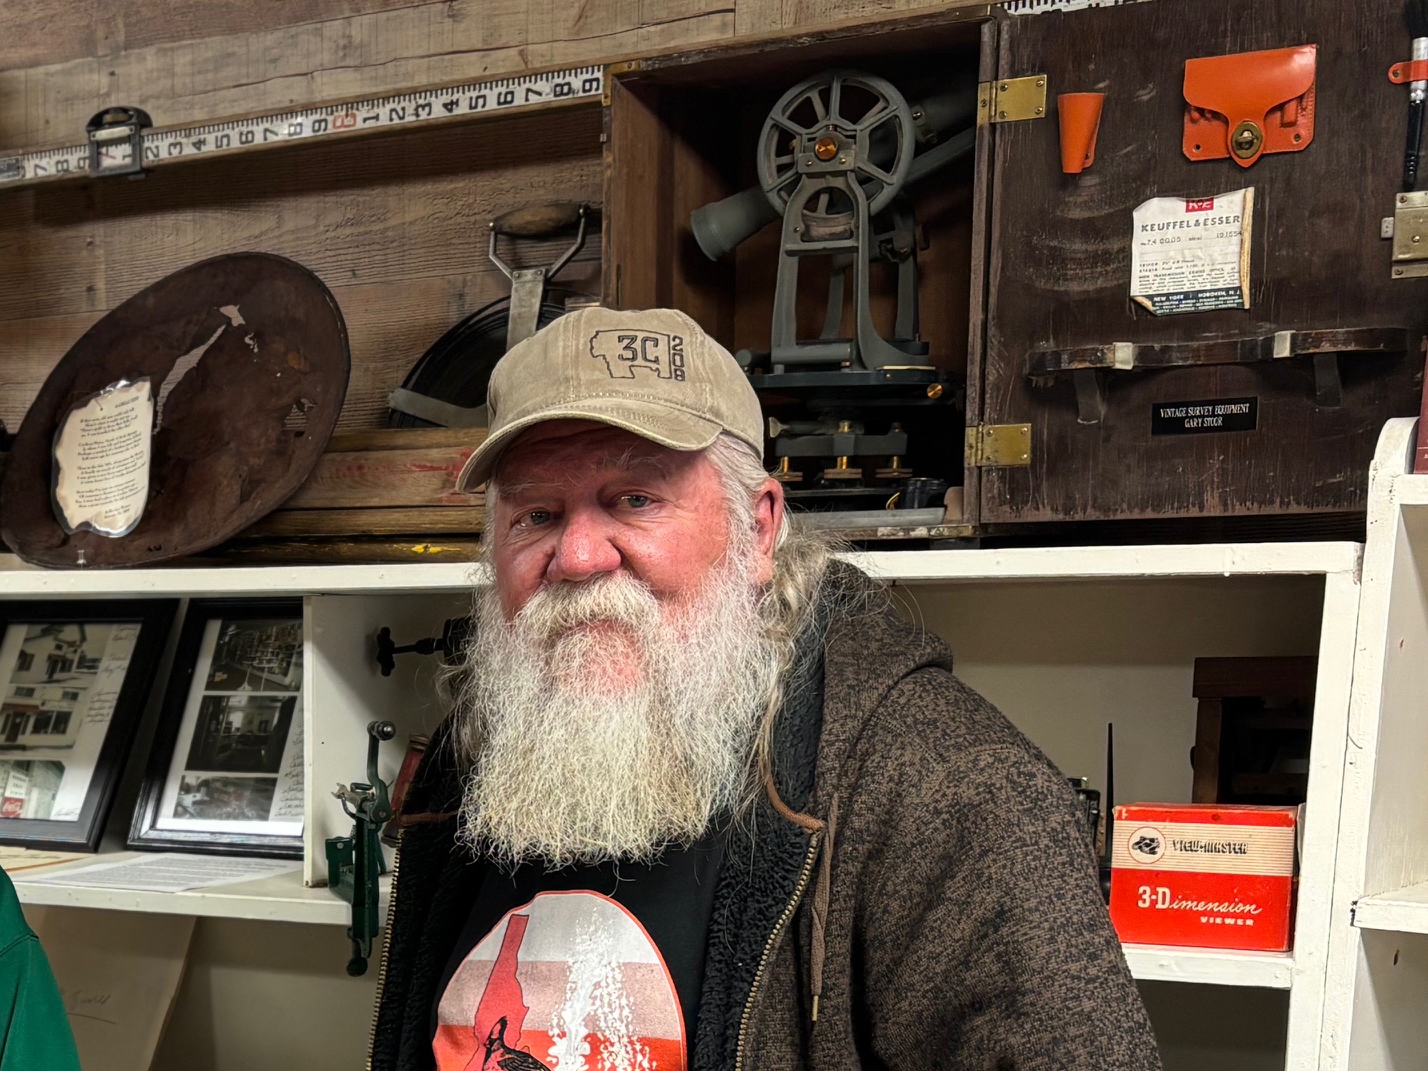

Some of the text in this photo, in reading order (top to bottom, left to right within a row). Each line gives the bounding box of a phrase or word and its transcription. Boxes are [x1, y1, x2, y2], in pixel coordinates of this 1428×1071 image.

[34, 164, 47, 175] 7
[55, 160, 70, 174] 8
[145, 144, 160, 159] 2
[168, 141, 183, 155] 3
[191, 138, 206, 152] 4
[215, 135, 231, 149] 5
[239, 131, 254, 144] 6
[263, 127, 279, 141] 7
[288, 122, 303, 137] 8
[312, 118, 328, 133] 9
[363, 112, 379, 123] 1
[389, 107, 405, 121] 2
[414, 103, 432, 117] 3
[442, 98, 459, 113] 4
[469, 95, 486, 110] 5
[497, 90, 514, 105] 6
[525, 88, 543, 102] 7
[553, 82, 572, 98] 8
[582, 77, 600, 92] 9
[1141, 215, 1241, 232] KEUFFEL & ESSER
[618, 335, 685, 381] 3C 208
[1160, 403, 1250, 418] VINTAGE SURVEY EQUIPMENT
[1184, 418, 1202, 428] GARY
[1137, 886, 1262, 914] 3-Dimension
[1200, 916, 1254, 926] VIEWER
